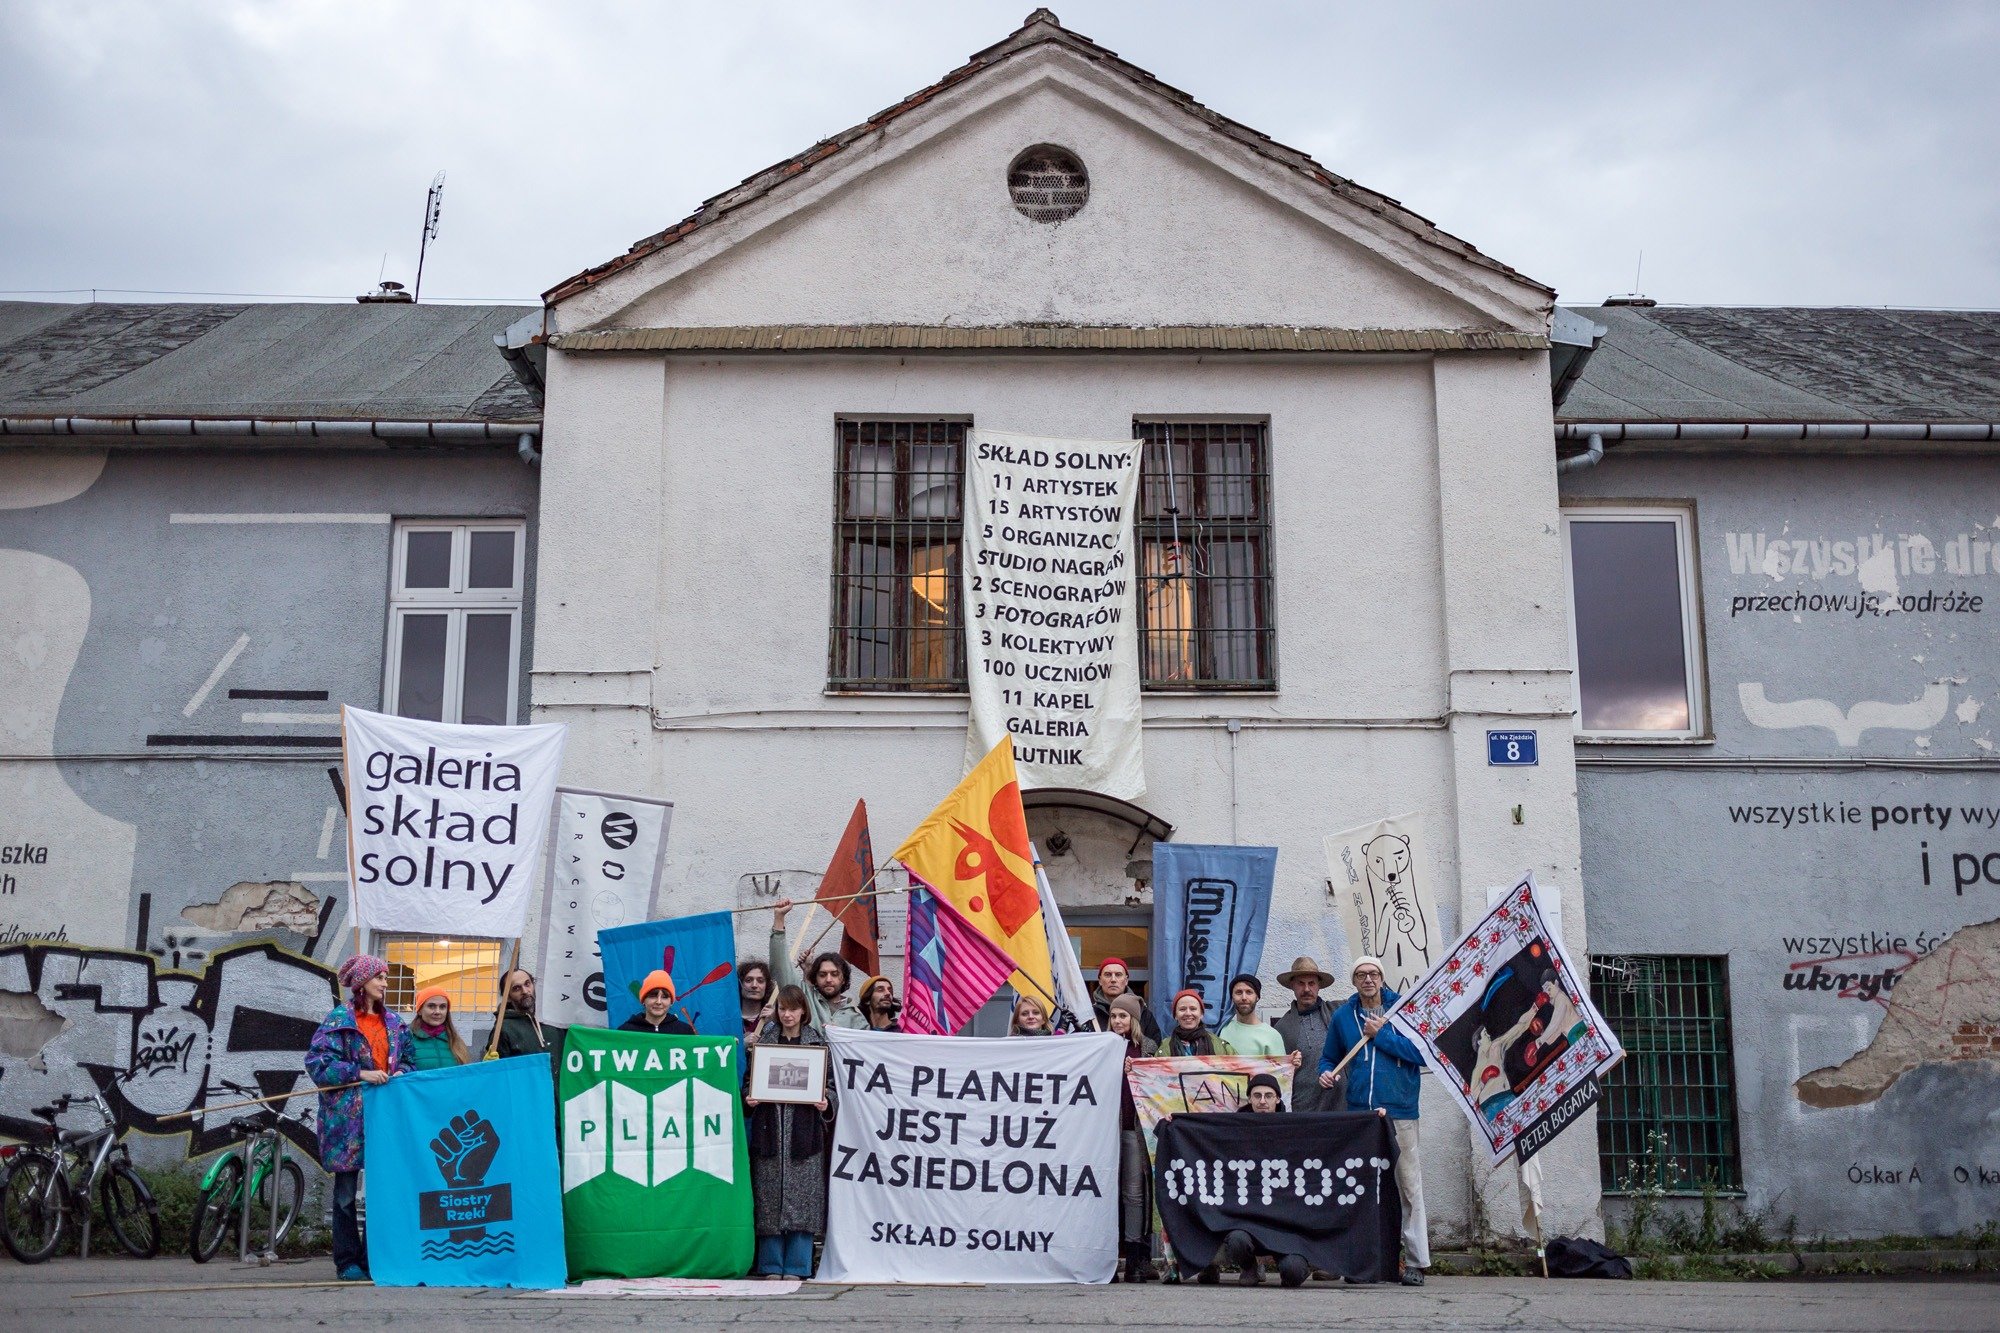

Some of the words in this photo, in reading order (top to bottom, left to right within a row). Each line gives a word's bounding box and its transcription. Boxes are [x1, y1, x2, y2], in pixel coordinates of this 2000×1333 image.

[978, 443, 1049, 467] SKŁAD
[1055, 452, 1132, 470] SOLNY:
[993, 474, 1012, 490] 11
[1023, 477, 1118, 497] ARTYSTEK
[989, 499, 1010, 515] 15
[1018, 503, 1122, 523] ARTYSTÓW
[983, 525, 994, 539] 5
[977, 549, 1047, 573] STUDIO
[1051, 550, 1124, 577] NAGRAŃ
[972, 576, 982, 592] 2
[990, 577, 1126, 603] SCENOGRAFÓW
[975, 603, 986, 618] 3
[994, 605, 1121, 629] FOTOGRAFÓW
[981, 630, 992, 646] 3
[1001, 632, 1115, 655] KOLEKTYWY
[983, 658, 1015, 677] 100
[1024, 662, 1112, 682] UCZNIÓW
[1002, 689, 1022, 706] 11
[1033, 692, 1094, 709] KAPEL
[1006, 717, 1089, 737] GALERIA
[1012, 745, 1083, 765] LUTNIK
[1507, 741, 1520, 760] 8
[365, 746, 521, 792] galeria
[363, 794, 518, 845] skład
[1729, 801, 1861, 829] wszystkie
[1871, 803, 1952, 831] porty
[358, 846, 515, 905] solny
[1921, 841, 1931, 886] i
[560, 811, 586, 1002] PRACOWNIA
[1783, 931, 1907, 959] wszystkie
[566, 1045, 732, 1073] OTWARTY
[842, 1058, 893, 1095] TA
[911, 1065, 1097, 1106] PLANETA
[580, 1113, 721, 1142] PLAN
[876, 1108, 966, 1145] JEST
[980, 1110, 1057, 1149] JUŻ
[1520, 1121, 1551, 1155] PETER
[1550, 1080, 1598, 1130] BOGATKA
[832, 1144, 1102, 1198] ZASIEDLONA
[1165, 1157, 1390, 1205] OUTPOST
[1847, 1162, 1902, 1184] Óskar
[439, 1193, 492, 1208] Siostry
[446, 1206, 487, 1221] Rzeki
[870, 1221, 956, 1248] SKŁAD
[966, 1228, 1055, 1253] SOLNY
